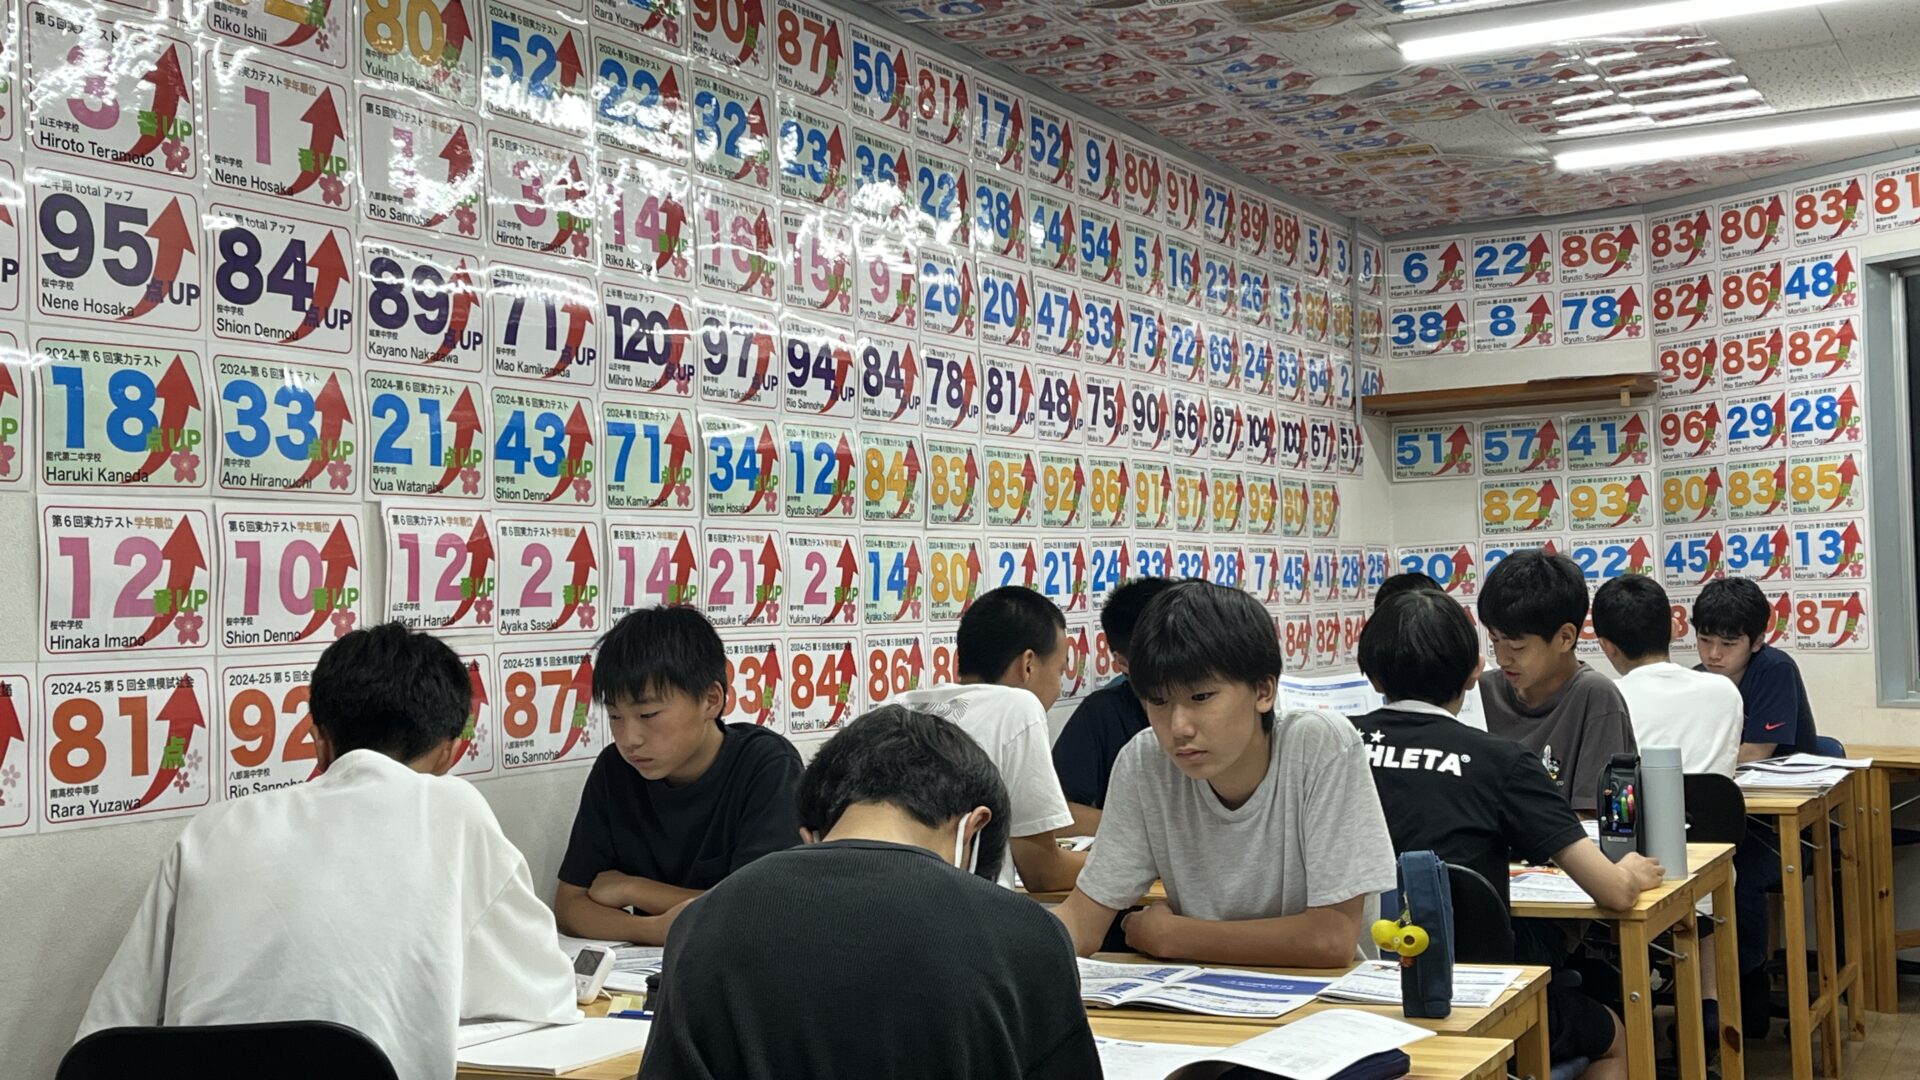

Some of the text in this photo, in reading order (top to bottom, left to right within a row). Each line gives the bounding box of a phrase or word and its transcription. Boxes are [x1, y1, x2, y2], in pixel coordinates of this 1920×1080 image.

[214, 14, 267, 41] Riko Ishii
[777, 9, 825, 74] 87
[365, 60, 399, 83] Yukina
[853, 41, 895, 104] 50
[918, 68, 950, 126] 81
[39, 116, 80, 134] 山王中学校
[244, 86, 271, 165] 1
[1030, 116, 1062, 168] 52
[40, 132, 155, 167] Hiroto Teramoto
[1086, 139, 1100, 183] 9
[75, 184, 133, 202] total アップ
[215, 169, 293, 196] Nene Hosaka
[246, 217, 295, 234] total アップ
[369, 202, 386, 218] Rio
[1205, 187, 1227, 229] 27
[1720, 205, 1767, 244] 80
[1794, 189, 1844, 230] 83
[39, 193, 154, 287] 95
[496, 232, 566, 255] Hiroto Teramoto
[1081, 219, 1110, 266] 54
[1134, 236, 1147, 278] 5
[1561, 232, 1618, 268] 86
[1651, 220, 1694, 258] 83
[216, 227, 314, 313] 84
[1403, 252, 1428, 284] 6
[1474, 242, 1527, 277] 22
[41, 278, 75, 291] 桜中学校
[168, 282, 201, 306] UP
[369, 256, 450, 335] 89
[1785, 261, 1835, 300] 48
[42, 294, 135, 317] Nene Hosaka
[217, 304, 244, 317] 桜中学校
[324, 309, 352, 332] UP
[983, 276, 1018, 328] 20
[1037, 291, 1070, 338] 47
[1562, 295, 1618, 331] 78
[217, 317, 251, 335] Shion
[606, 303, 671, 366] 120
[1085, 303, 1113, 348] 33
[1130, 313, 1157, 358] 73
[1391, 311, 1444, 346] 38
[1490, 305, 1516, 337] 8
[368, 342, 459, 364] Kayano Nakazawa
[787, 338, 836, 391] 94
[1209, 334, 1232, 374] 69
[1722, 337, 1769, 375] 85
[1789, 327, 1839, 367] 82
[609, 374, 633, 386] Mihiro
[863, 345, 905, 400] 84
[926, 356, 964, 409] 78
[986, 367, 1016, 415] 81
[52, 365, 159, 453] 18
[703, 386, 728, 399] Moriaki
[786, 398, 796, 408] Rio
[1039, 377, 1070, 423] 48
[1087, 384, 1116, 429] 75
[223, 379, 318, 461] 33
[371, 393, 443, 466] 21
[1132, 391, 1159, 433] 90
[1660, 410, 1704, 447] 96
[1727, 403, 1774, 440] 29
[1789, 395, 1840, 433] 28
[169, 429, 201, 451] UP
[327, 441, 354, 460] UP
[494, 409, 566, 478] 43
[607, 421, 660, 484] 71
[1311, 424, 1329, 458] 67
[1397, 433, 1443, 466] 51
[1484, 428, 1537, 463] 57
[1567, 422, 1617, 456] 41
[46, 466, 148, 484] Haruki Kaneda
[459, 450, 483, 468] UP
[709, 437, 760, 492] 34
[789, 441, 835, 495] 12
[864, 447, 906, 502] 84
[222, 471, 312, 489] Ano Hiranouchi
[373, 478, 443, 493] Yua Watanabe
[495, 487, 550, 501] Shion Denno
[987, 460, 1023, 509] 85
[1043, 464, 1074, 512] 92
[1091, 468, 1119, 513] 86
[1663, 476, 1706, 512] 80
[1728, 468, 1776, 507] 83
[1791, 463, 1840, 502] 85
[709, 504, 725, 513] Nene
[1483, 489, 1540, 523] 82
[1570, 483, 1627, 518] 93
[1572, 546, 1627, 578] 22
[1665, 540, 1708, 574] 45
[1727, 533, 1773, 570] 34
[1796, 529, 1842, 566] 13
[58, 536, 164, 619] 12
[235, 539, 324, 616] 10
[398, 532, 467, 602] 12
[520, 542, 552, 607] 2
[708, 548, 755, 605] 21
[804, 551, 827, 605] 2
[868, 551, 907, 601] 14
[930, 552, 968, 603] 80
[1044, 551, 1072, 595] 21
[1255, 556, 1265, 591] 7
[176, 589, 208, 612] UP
[789, 614, 812, 624] Yukina
[1796, 600, 1845, 635] 87
[50, 620, 83, 630] 桜中学校
[50, 633, 146, 650] Hinaka Imano
[226, 629, 301, 644] Shion Denno
[501, 621, 528, 633] Ayaka
[229, 673, 271, 686] 2024-25
[503, 658, 535, 669] 2024-25
[790, 654, 839, 710] 84
[51, 681, 101, 696] 2024-25
[503, 669, 572, 739] 87
[49, 696, 149, 785] 81
[505, 749, 560, 764] Rio Sannohe
[1364, 744, 1462, 776] HLETA
[50, 797, 141, 819] Rara Yuzawa
